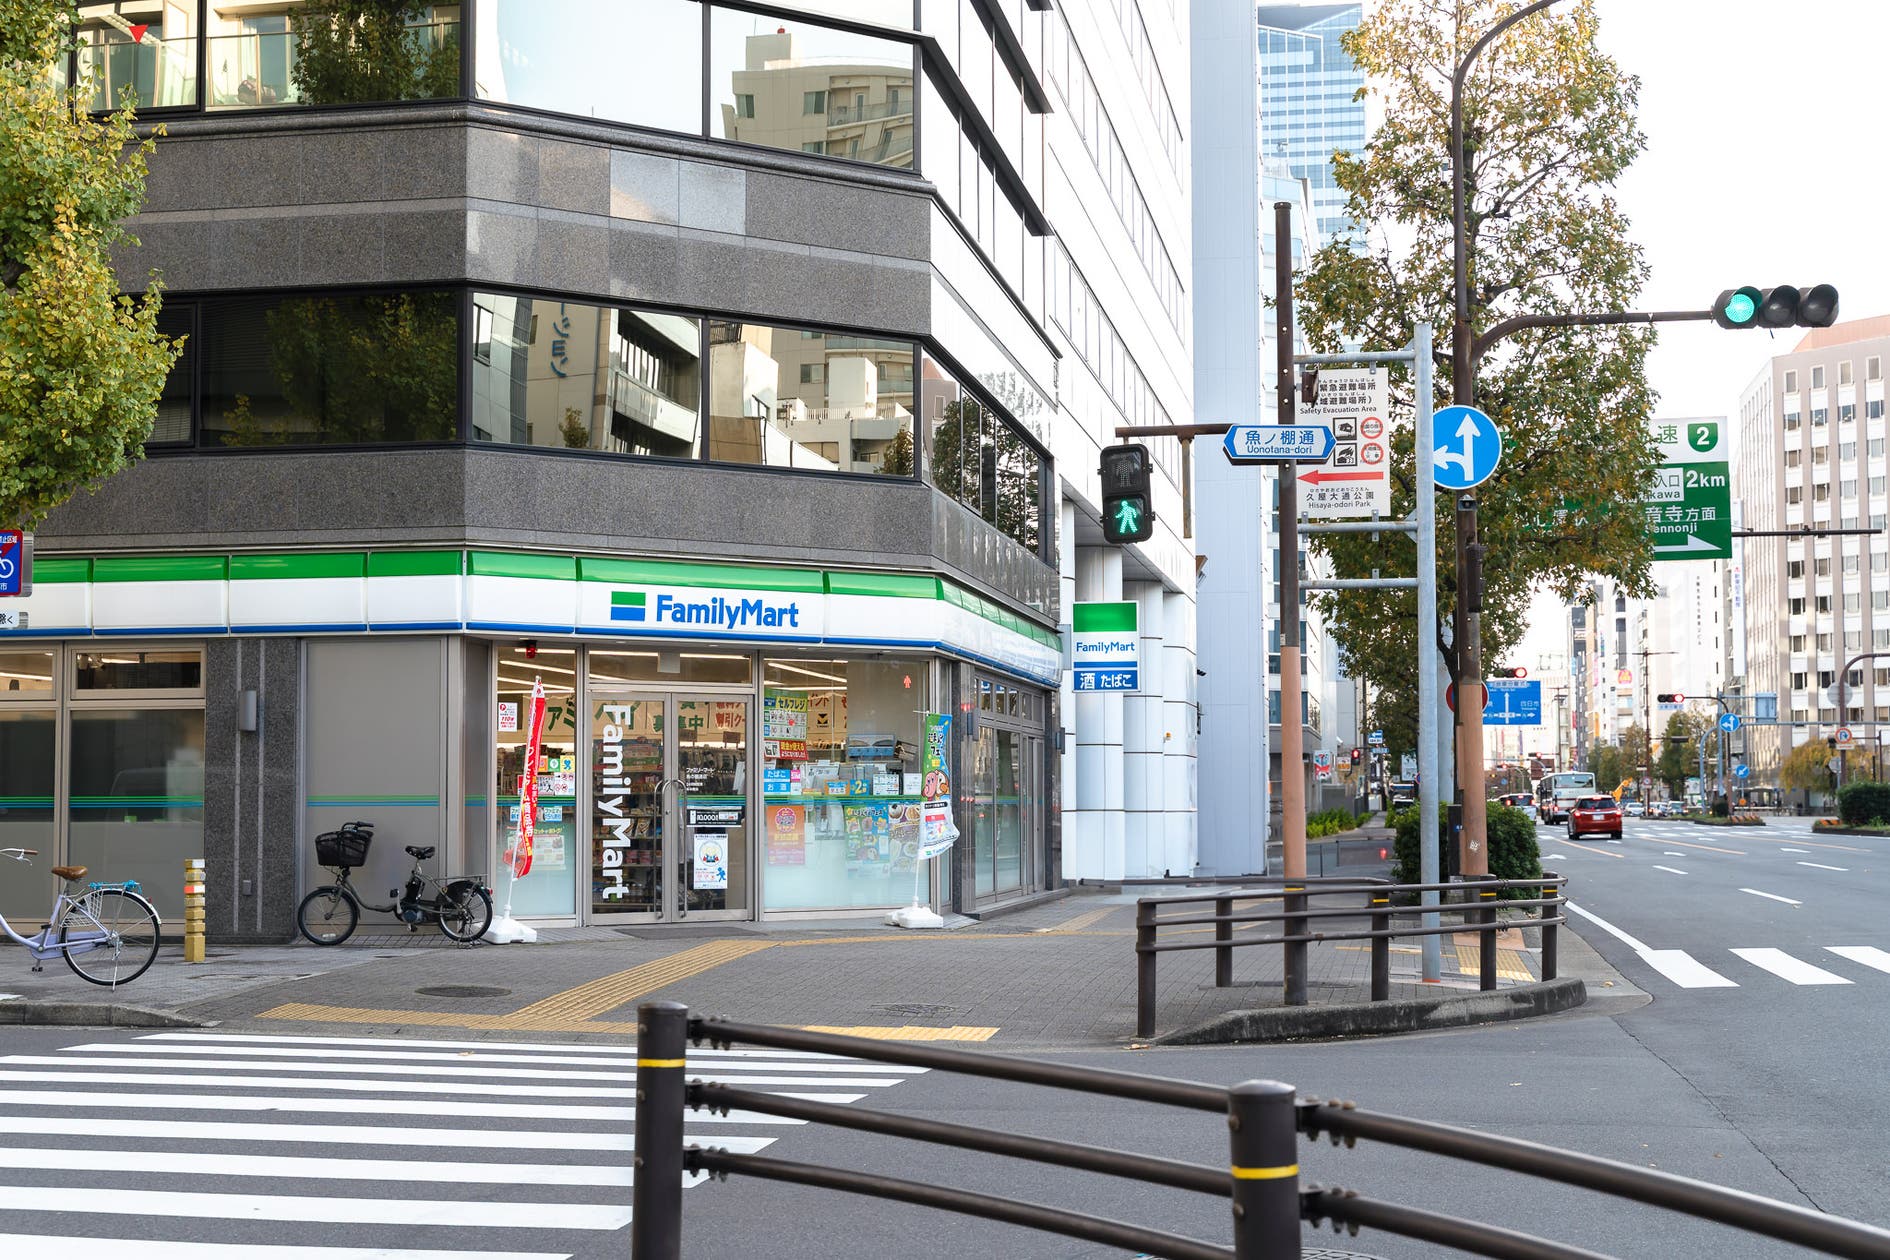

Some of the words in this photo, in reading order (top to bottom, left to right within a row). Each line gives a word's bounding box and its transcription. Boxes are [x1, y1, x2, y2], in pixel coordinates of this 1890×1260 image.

[1300, 406, 1321, 415] Safety
[1323, 406, 1360, 414] Evacuation
[1361, 405, 1377, 413] Area
[1245, 430, 1314, 445] 魚ノ棚通
[1696, 427, 1710, 445] 2
[1247, 445, 1312, 454] Uonotana-dori
[1686, 470, 1726, 488] 2km
[1306, 491, 1374, 501] 久屋大通公園
[1308, 501, 1354, 510] Hisaya-odori
[656, 594, 799, 629] FamilyMart
[1076, 641, 1136, 654] FamilyMart
[1080, 672, 1096, 689] 酒
[1100, 673, 1132, 688] たばこ
[767, 770, 787, 778] たばこ
[598, 704, 632, 900] FamilyMart
